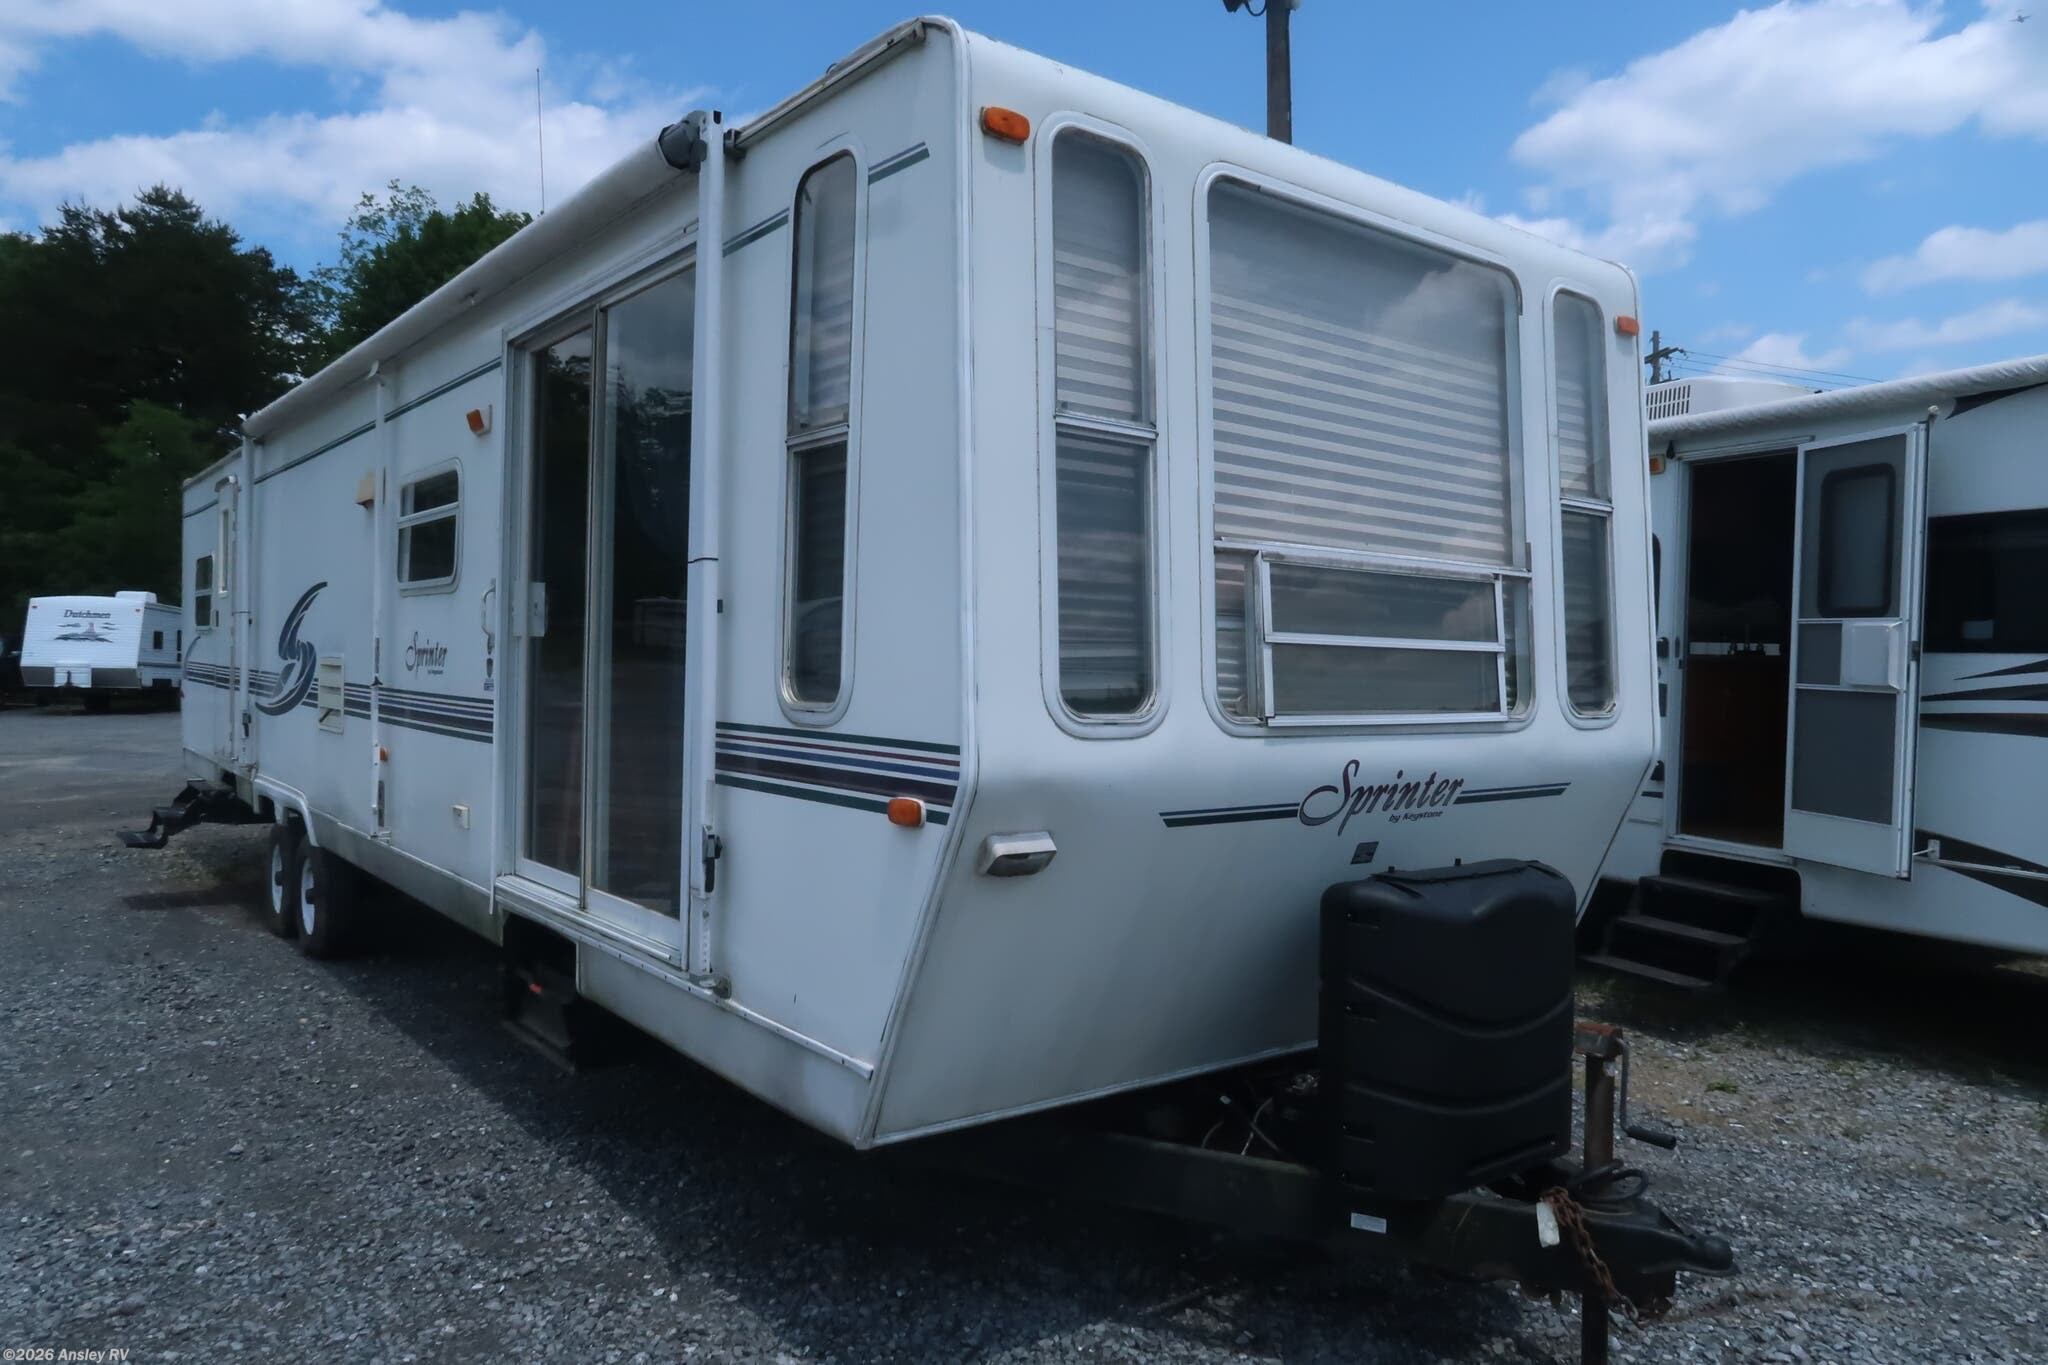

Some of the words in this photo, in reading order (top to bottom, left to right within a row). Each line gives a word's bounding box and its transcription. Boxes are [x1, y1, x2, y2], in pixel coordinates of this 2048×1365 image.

[405, 631, 447, 678] Sprinter
[1300, 759, 1464, 837] Sprinter
[1389, 814, 1401, 823] by
[1402, 811, 1443, 822] Keystone
